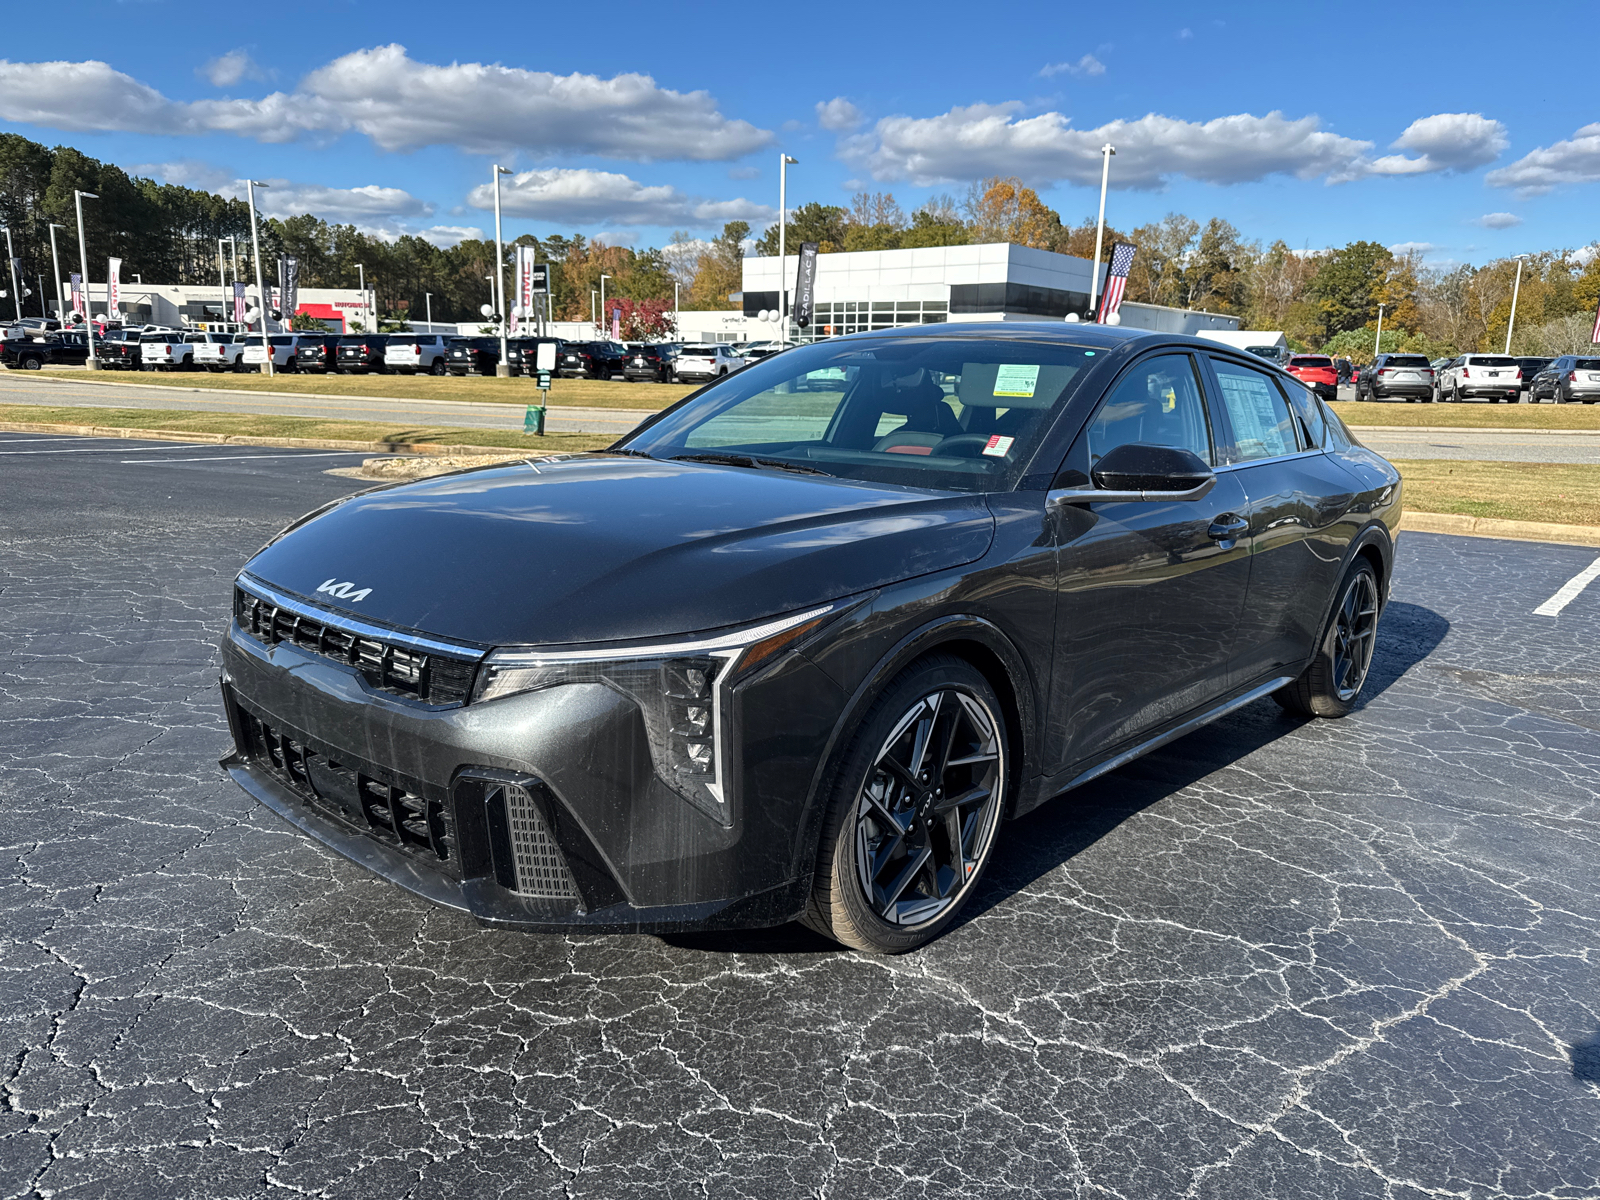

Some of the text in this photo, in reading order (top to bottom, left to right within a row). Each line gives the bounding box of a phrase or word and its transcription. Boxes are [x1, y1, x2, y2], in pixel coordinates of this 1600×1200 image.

[286, 265, 294, 316] CADILLAC
[521, 261, 531, 307] GMC
[801, 260, 812, 317] CADILLAC
[316, 578, 373, 603] KIA
